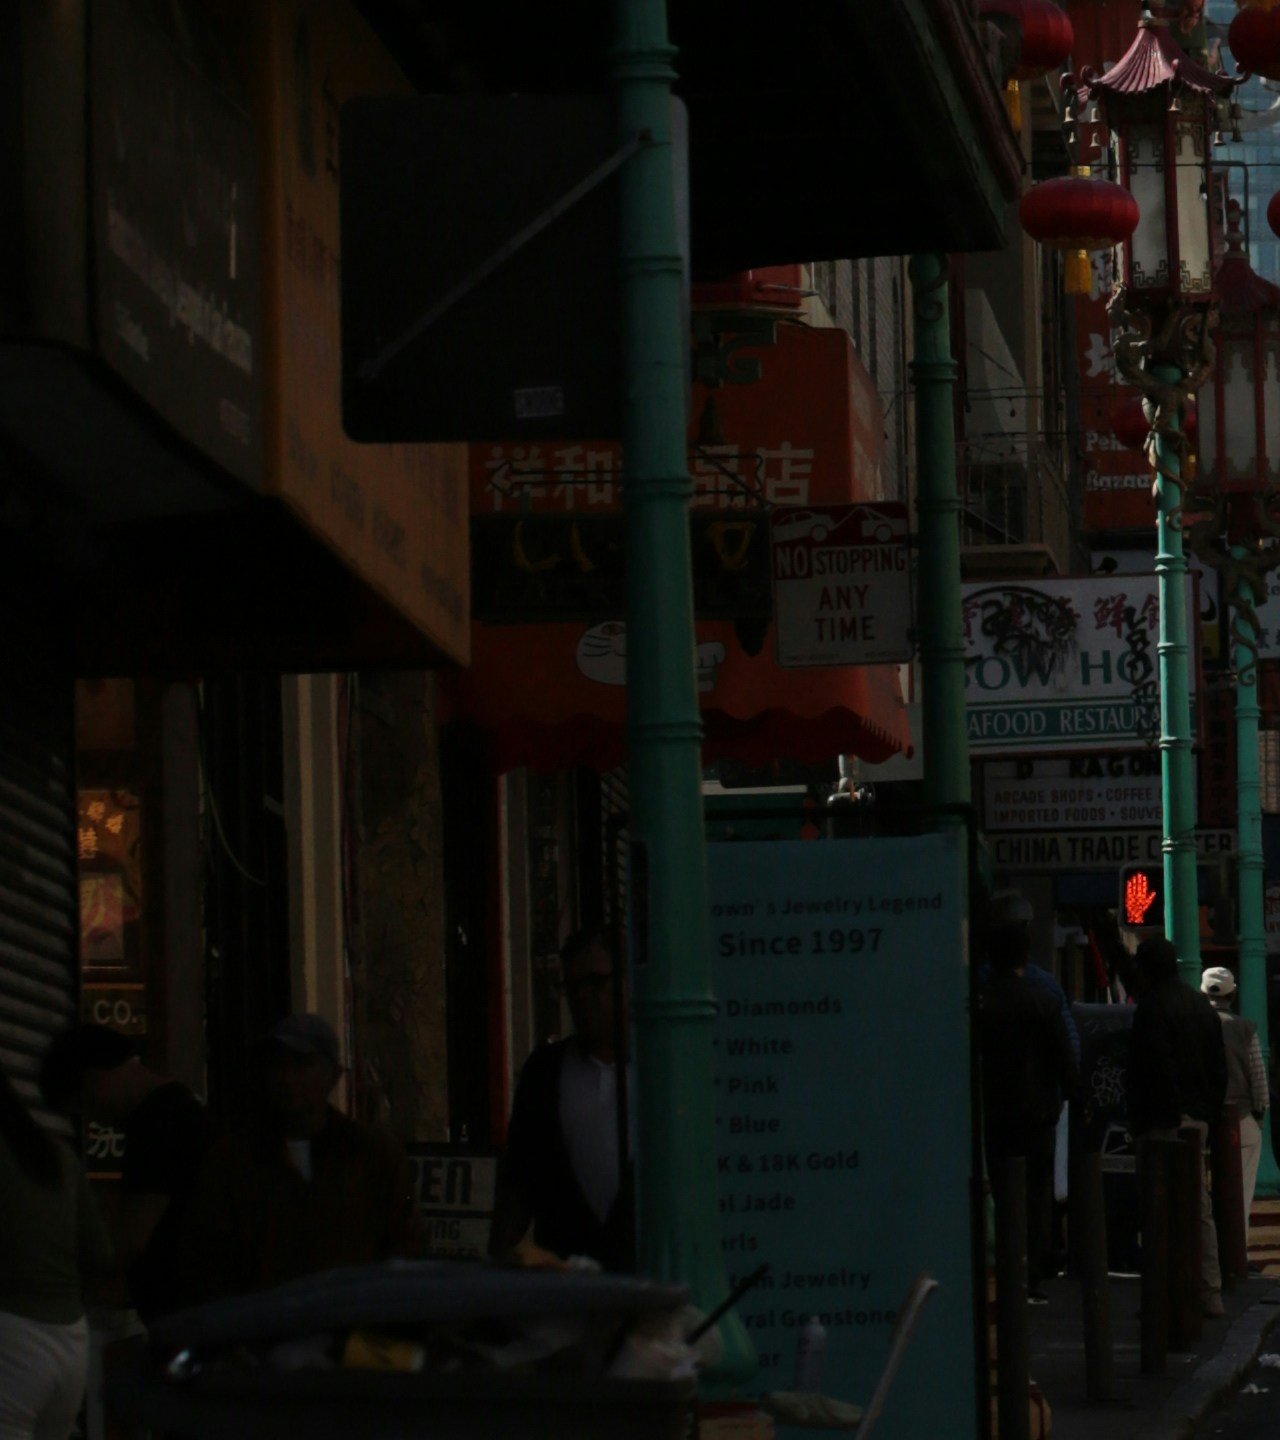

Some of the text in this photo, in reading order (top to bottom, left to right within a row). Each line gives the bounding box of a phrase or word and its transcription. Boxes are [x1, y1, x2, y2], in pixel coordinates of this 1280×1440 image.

[1087, 471, 1150, 491] Bazaa
[774, 546, 905, 576] NO STOPPING
[819, 584, 870, 611] ANY
[815, 616, 875, 642] TIME
[968, 706, 1162, 737] AFOOD RESTAURA
[994, 786, 1154, 804] ARCADE SHOPS COFFEE
[994, 805, 1162, 823] IMPORTED FOODS SOUVE
[995, 836, 1061, 864] CHINA
[1068, 834, 1140, 862] TRADE
[782, 896, 863, 917] Jewelry
[868, 892, 943, 915] Legend
[719, 928, 884, 958] Since 1997
[727, 996, 843, 1017] Diamonds
[726, 1037, 794, 1056] White
[728, 1075, 780, 1094] Pink
[729, 1114, 781, 1134] Blue
[759, 1153, 801, 1172] 18K
[806, 1149, 860, 1171] Gold
[742, 1192, 796, 1212] Jade
[781, 1266, 872, 1291] Jewelry
